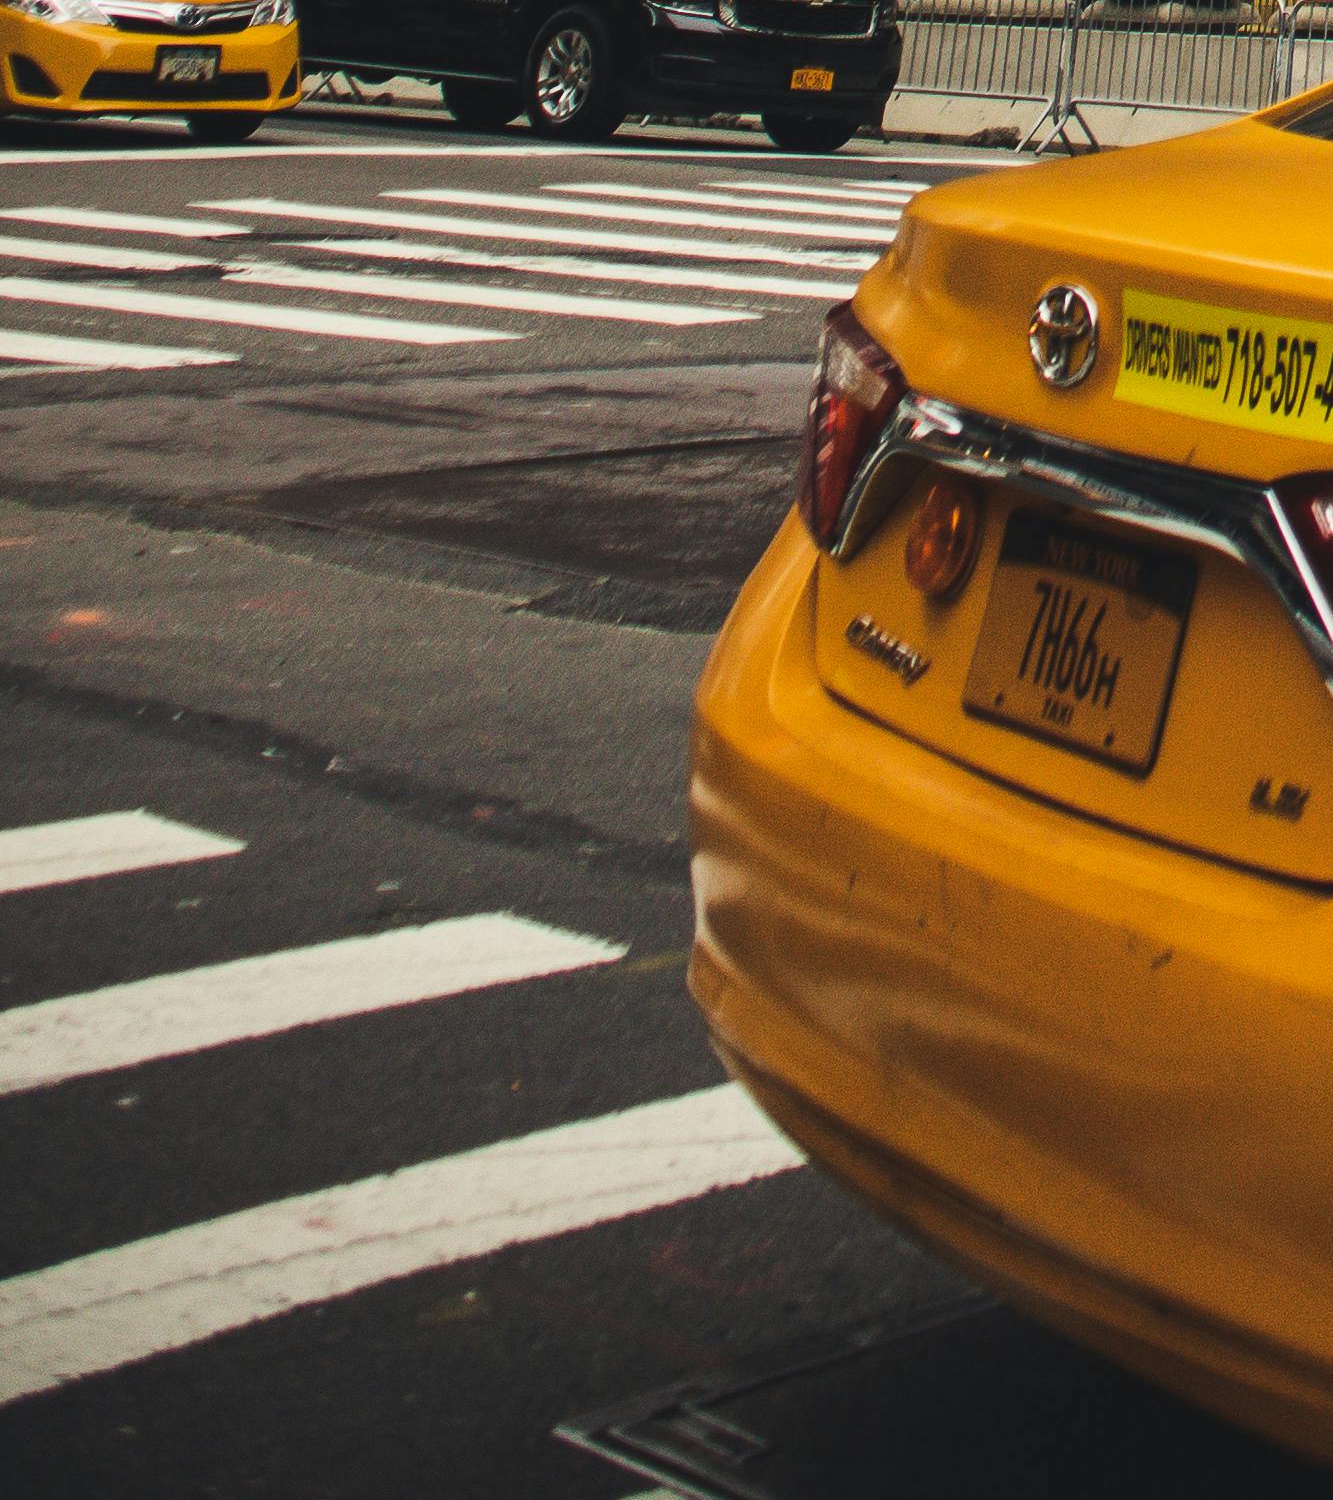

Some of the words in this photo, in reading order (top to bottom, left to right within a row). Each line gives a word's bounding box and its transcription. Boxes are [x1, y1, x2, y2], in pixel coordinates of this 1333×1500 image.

[1125, 318, 1171, 380] DRIVERS
[1172, 329, 1222, 390] WANTED
[1046, 536, 1090, 570] NEW
[1093, 547, 1143, 584] YORK
[1017, 579, 1121, 708] 7H66H
